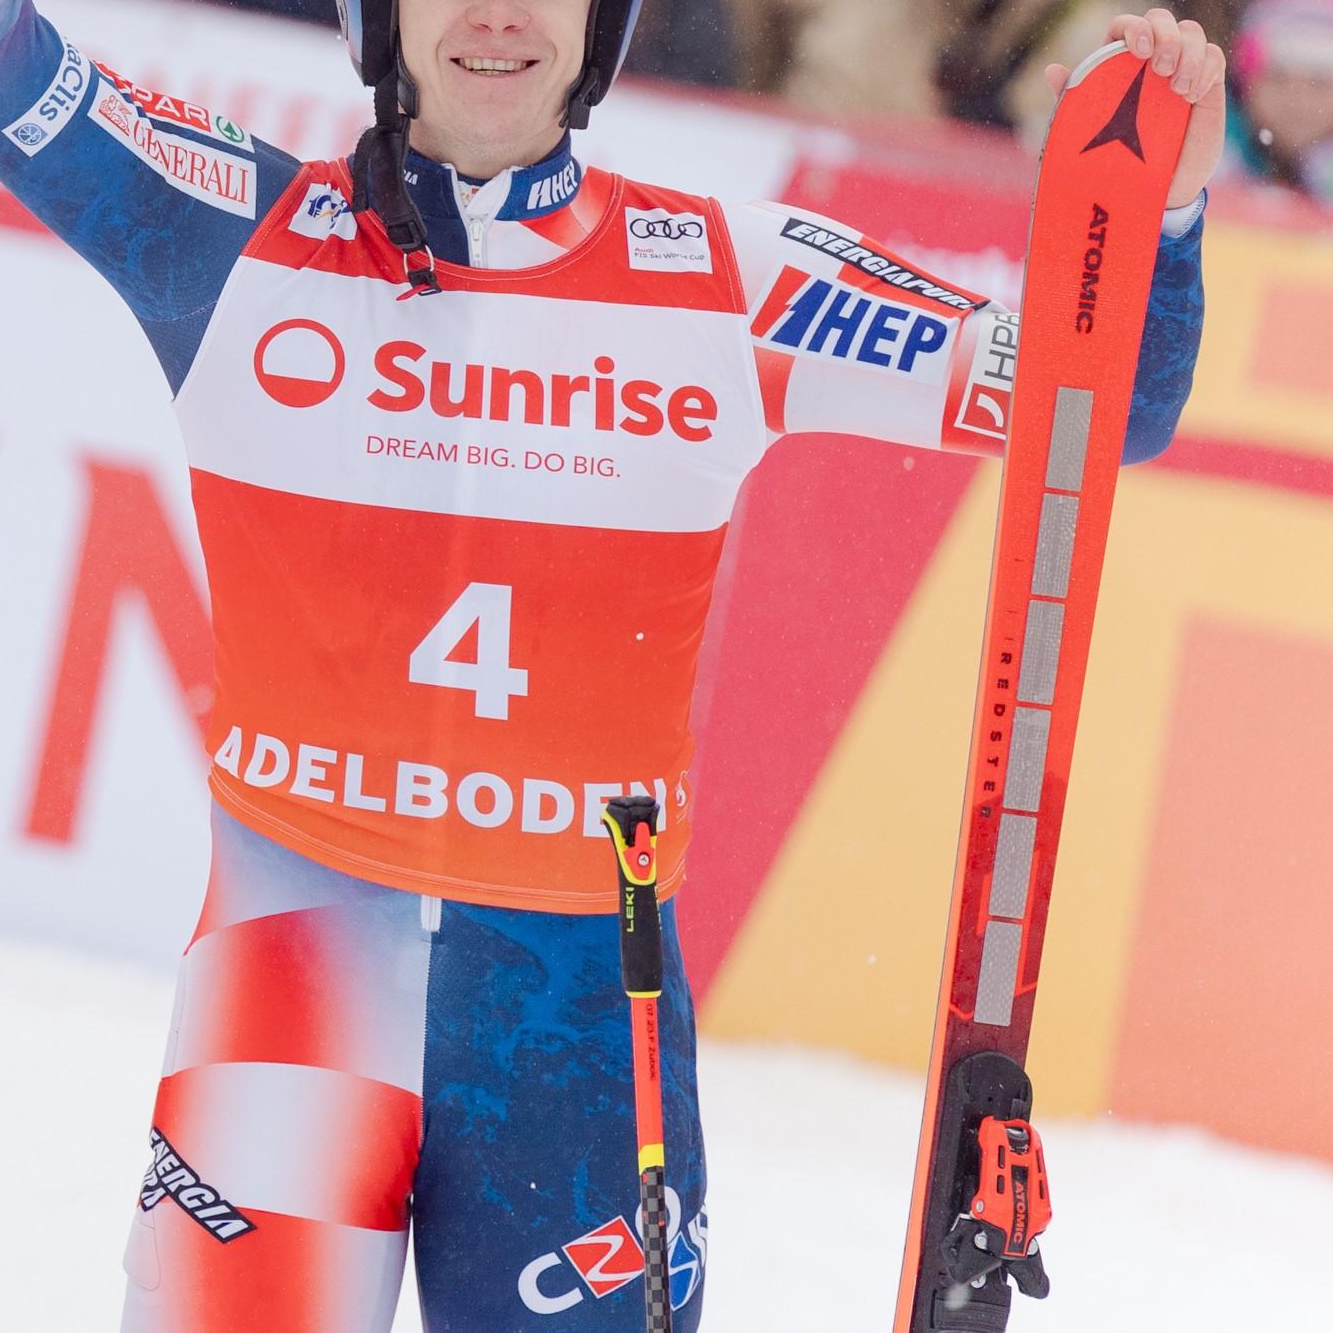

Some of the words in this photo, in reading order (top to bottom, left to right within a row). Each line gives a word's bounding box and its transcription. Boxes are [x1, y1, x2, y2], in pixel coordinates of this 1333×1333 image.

[133, 118, 249, 204] GENERALI
[1075, 202, 1110, 336] ATOMIC
[807, 288, 948, 374] HEP
[366, 340, 718, 443] Sunrise
[366, 435, 459, 463] DREAM
[467, 445, 517, 469] BIG.
[524, 451, 565, 474] DO
[573, 455, 622, 478] BIG.
[408, 581, 529, 721] 4
[981, 651, 1013, 819] REDSTER
[625, 886, 635, 933] LEKI
[1013, 1180, 1026, 1245] ATOMIC
